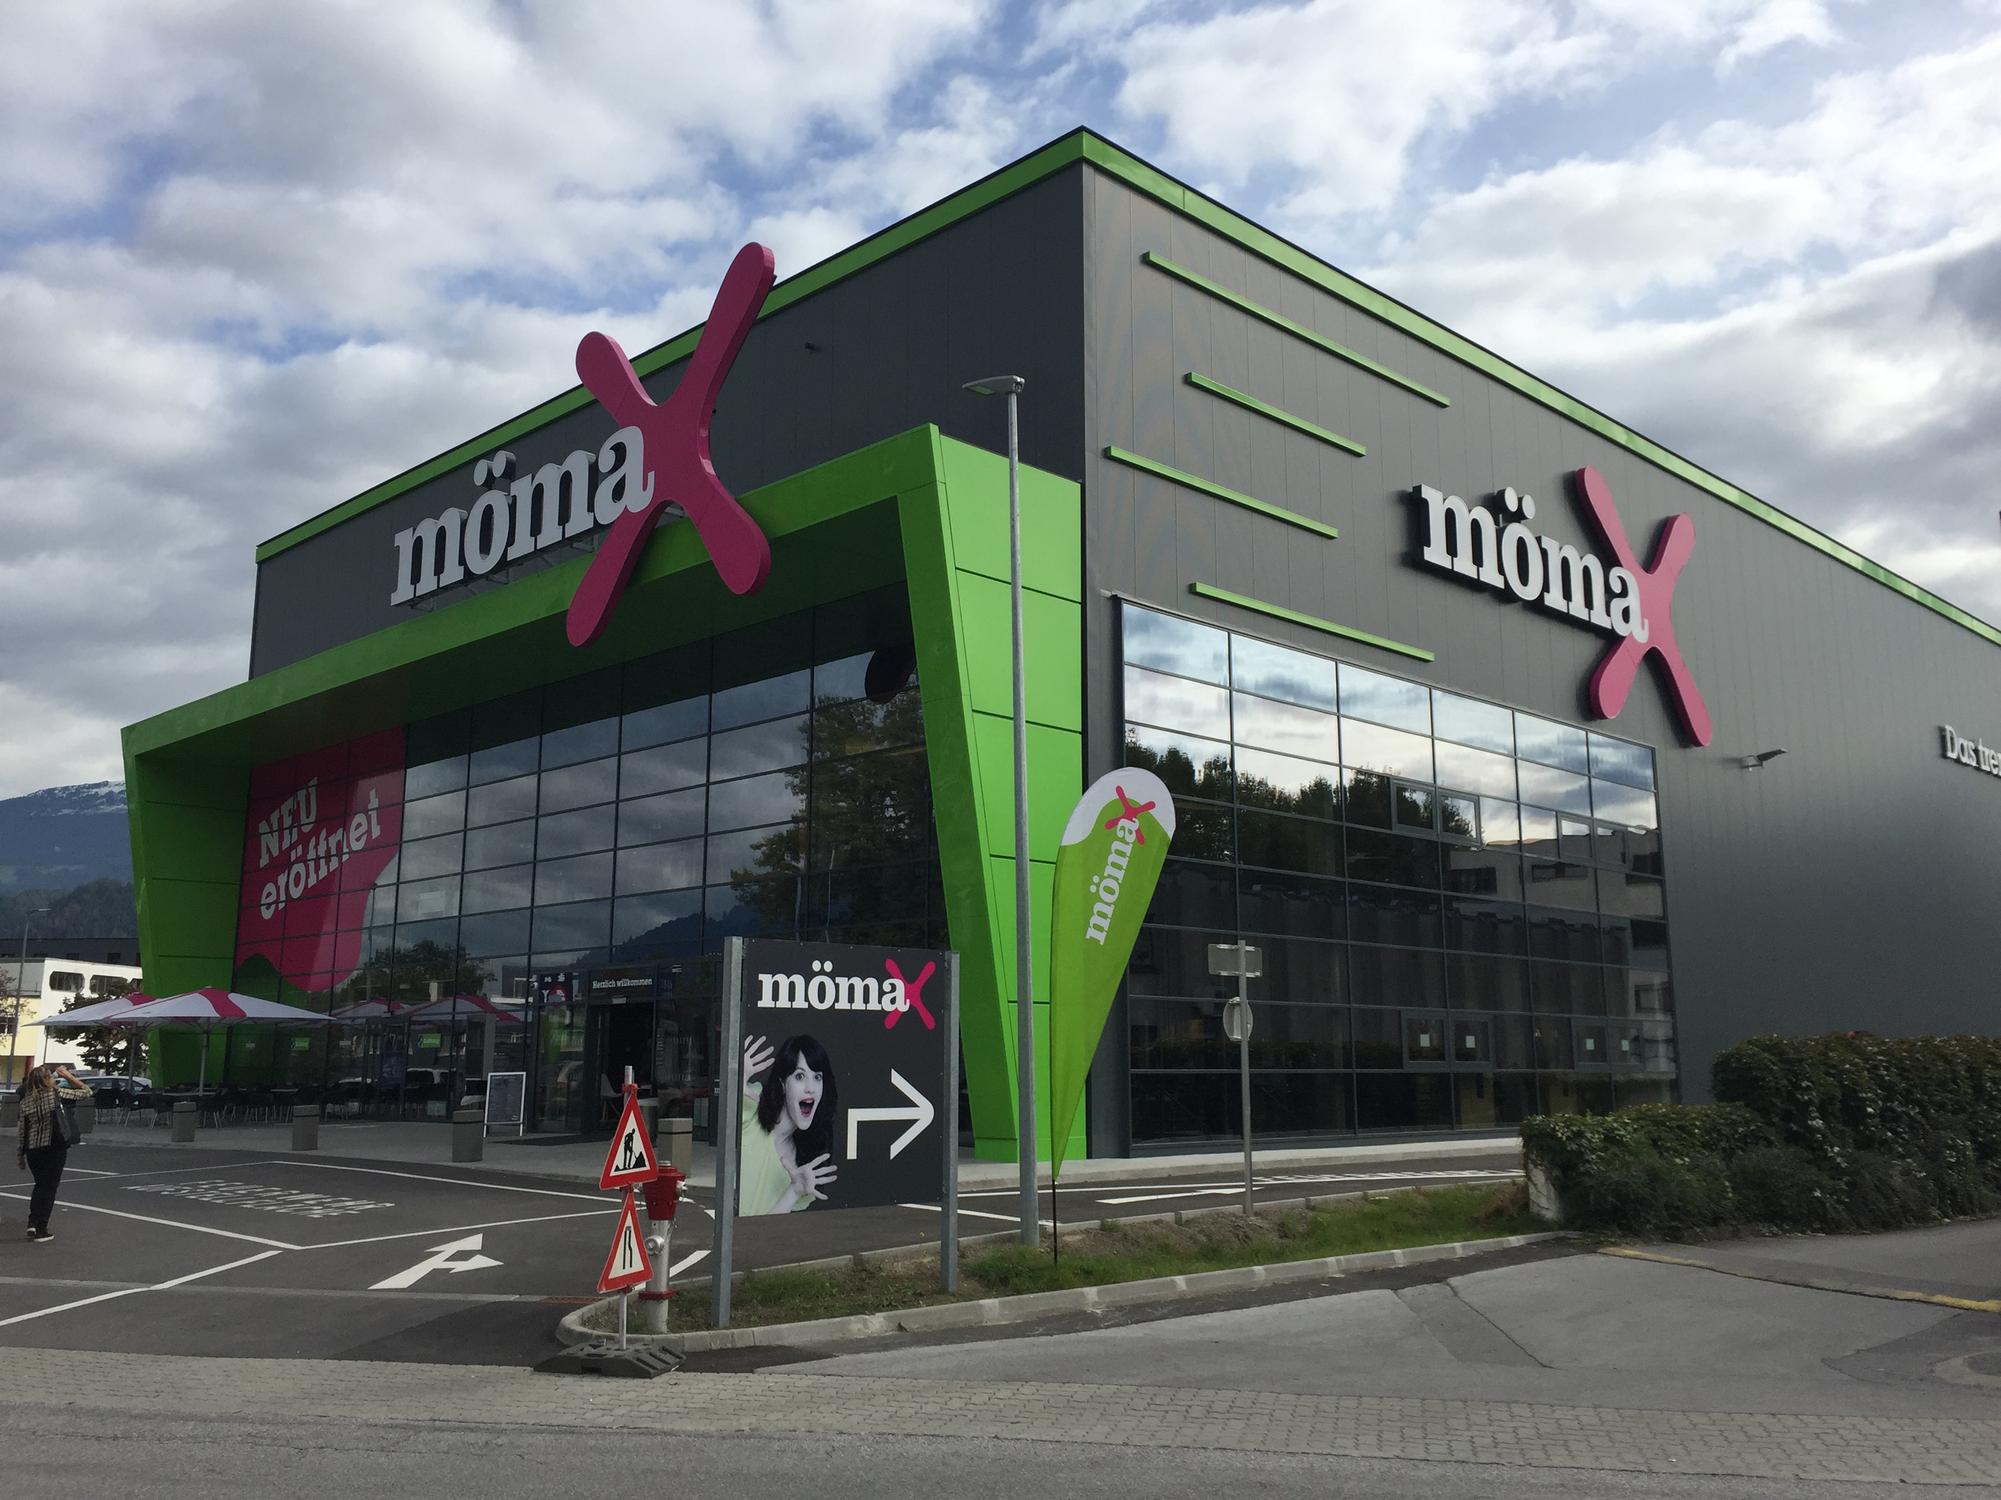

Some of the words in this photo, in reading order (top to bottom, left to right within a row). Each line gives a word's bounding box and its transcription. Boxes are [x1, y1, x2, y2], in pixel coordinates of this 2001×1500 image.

[1944, 724, 1979, 767] Das
[1979, 738, 2001, 776] tre
[258, 777, 318, 868] NEU
[260, 788, 381, 920] eröffnet
[592, 979, 616, 989] Herzlich
[616, 978, 653, 987] willkommen
